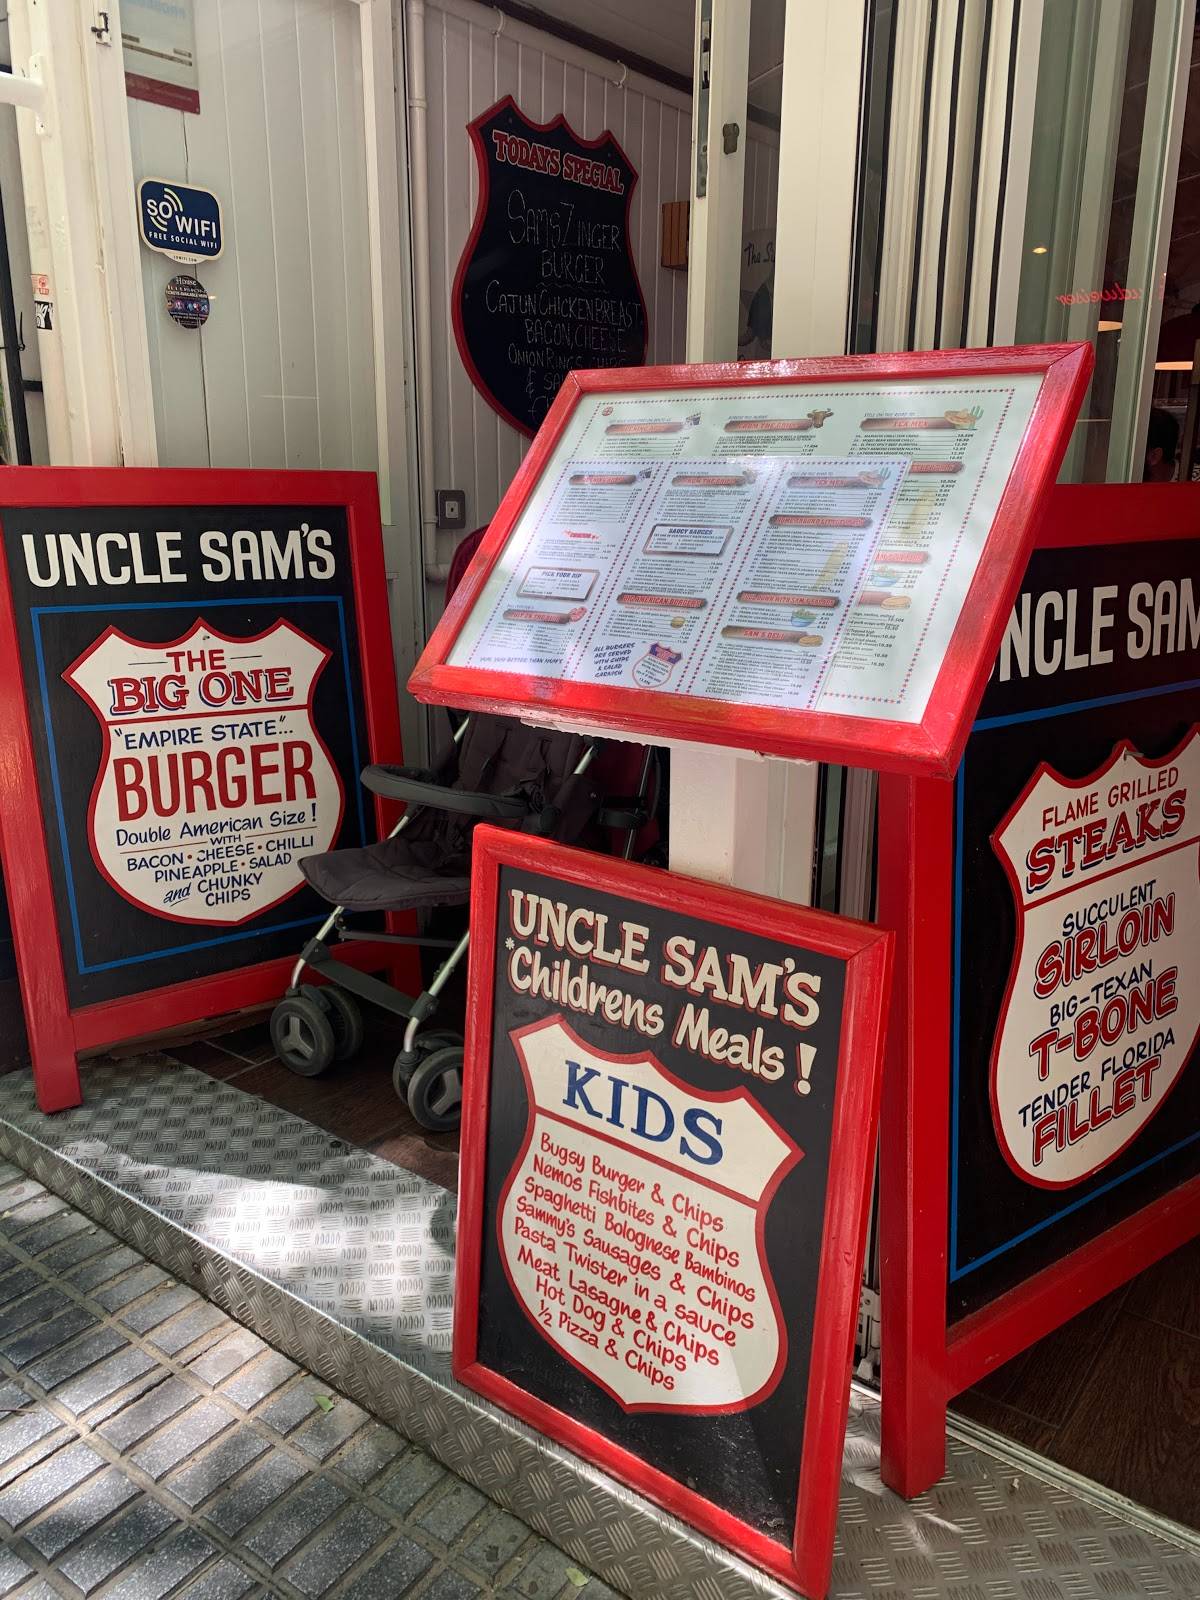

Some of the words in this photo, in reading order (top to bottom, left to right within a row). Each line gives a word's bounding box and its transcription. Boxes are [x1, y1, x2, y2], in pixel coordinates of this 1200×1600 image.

[492, 130, 560, 175] TODAYS
[562, 152, 624, 194] SPECIAL
[147, 199, 172, 218] SO
[148, 232, 168, 240] FREE
[170, 235, 198, 246] SOCIAL
[200, 240, 218, 248] WIFI
[175, 215, 216, 238] WIFI
[486, 280, 536, 313] CAJUN
[541, 250, 605, 285] BURGER
[508, 342, 544, 368] ONION
[22, 531, 188, 588] UNCLE
[200, 523, 336, 583] SAM'S
[166, 649, 226, 672] THE
[606, 642, 636, 650] BURGERS
[988, 585, 1118, 682] NCLE
[108, 674, 190, 716] BIG
[200, 667, 295, 708] ONE
[113, 740, 318, 822] BURGER
[1042, 792, 1099, 831] FLAME
[1108, 767, 1179, 807] GRILLED
[116, 824, 171, 846] Double
[180, 816, 263, 837] American
[270, 810, 306, 828] Size
[127, 853, 184, 871] BACON
[197, 842, 255, 862] CHEESE
[266, 836, 314, 852] CHILLI
[210, 834, 242, 845] WITH
[1026, 788, 1187, 893] STEAKS
[154, 861, 240, 883] PINEAPPLE
[249, 853, 292, 869] SALAD
[164, 884, 191, 906] and
[197, 872, 263, 893] CHUNKY
[205, 888, 251, 907] CHIPS
[1062, 879, 1156, 936] SUCCULENT
[508, 888, 650, 975] UNCLE
[661, 934, 822, 1028] SAM'S
[1033, 892, 1176, 999] SIRLOIN
[1029, 966, 1178, 1081] T-BONE
[1050, 959, 1153, 1027] BIG-TEXAN
[673, 1002, 786, 1083] Meals
[1018, 1071, 1090, 1127] TENDER
[1101, 1029, 1175, 1083] FLORIDA
[1032, 1054, 1161, 1167] FILLET
[562, 1059, 723, 1165] KIDS
[533, 1154, 583, 1192] Nemos
[588, 1179, 655, 1226] Fishbites
[662, 1215, 677, 1237] &
[686, 1227, 740, 1268] Chips
[541, 1132, 585, 1172] Bugsy
[592, 1155, 645, 1193] Burger
[651, 1183, 665, 1206] &
[672, 1193, 724, 1232] Chips
[516, 1196, 576, 1238] Sammy's
[583, 1227, 661, 1281] Sausages
[670, 1272, 686, 1295] &
[697, 1285, 755, 1330] Chips
[524, 1177, 597, 1224] Spaghetti
[604, 1211, 680, 1264] Bolognese
[685, 1251, 756, 1302] Bambinos
[515, 1217, 556, 1250] Pasta
[563, 1241, 628, 1287] Twister
[634, 1278, 650, 1302] in
[654, 1294, 667, 1312] a
[675, 1303, 737, 1347] sauce
[518, 1245, 560, 1282] Meat
[569, 1270, 641, 1322] Lasagne
[646, 1311, 658, 1332] &
[663, 1320, 720, 1367] Chips
[535, 1275, 566, 1306] Hot
[572, 1295, 605, 1332] Dog
[611, 1318, 625, 1338] &
[633, 1329, 687, 1372] Chips
[559, 1311, 599, 1349] Pizza
[604, 1338, 619, 1360] &
[625, 1349, 675, 1390] Chips
